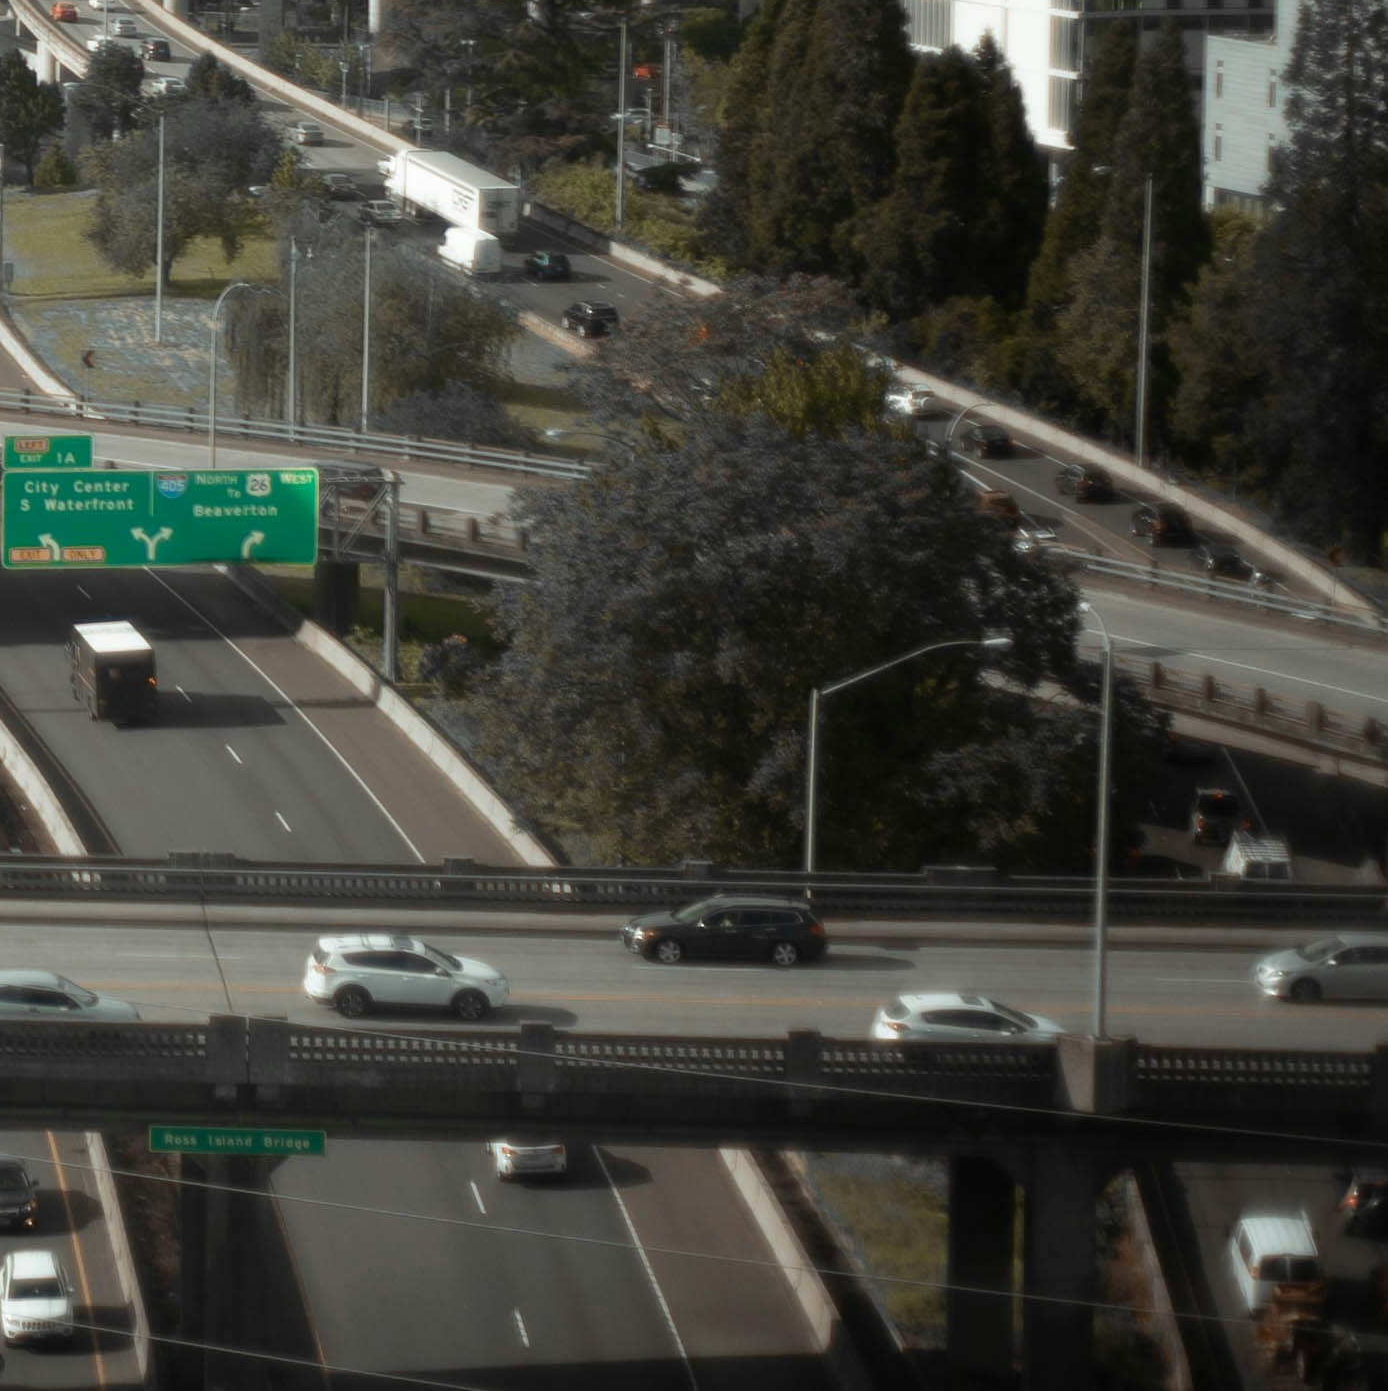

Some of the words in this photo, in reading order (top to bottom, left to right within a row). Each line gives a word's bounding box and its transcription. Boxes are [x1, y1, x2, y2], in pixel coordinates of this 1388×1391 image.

[56, 452, 76, 464] 1A
[24, 480, 59, 497] City
[73, 479, 130, 493] Center
[160, 480, 185, 492] 405
[250, 478, 268, 492] 26
[20, 498, 31, 511] S
[44, 498, 135, 511] Waterfront
[192, 504, 278, 517] Beaverton
[163, 1133, 198, 1147] Ross
[208, 1135, 253, 1148] Island
[263, 1136, 311, 1150] Bridge
